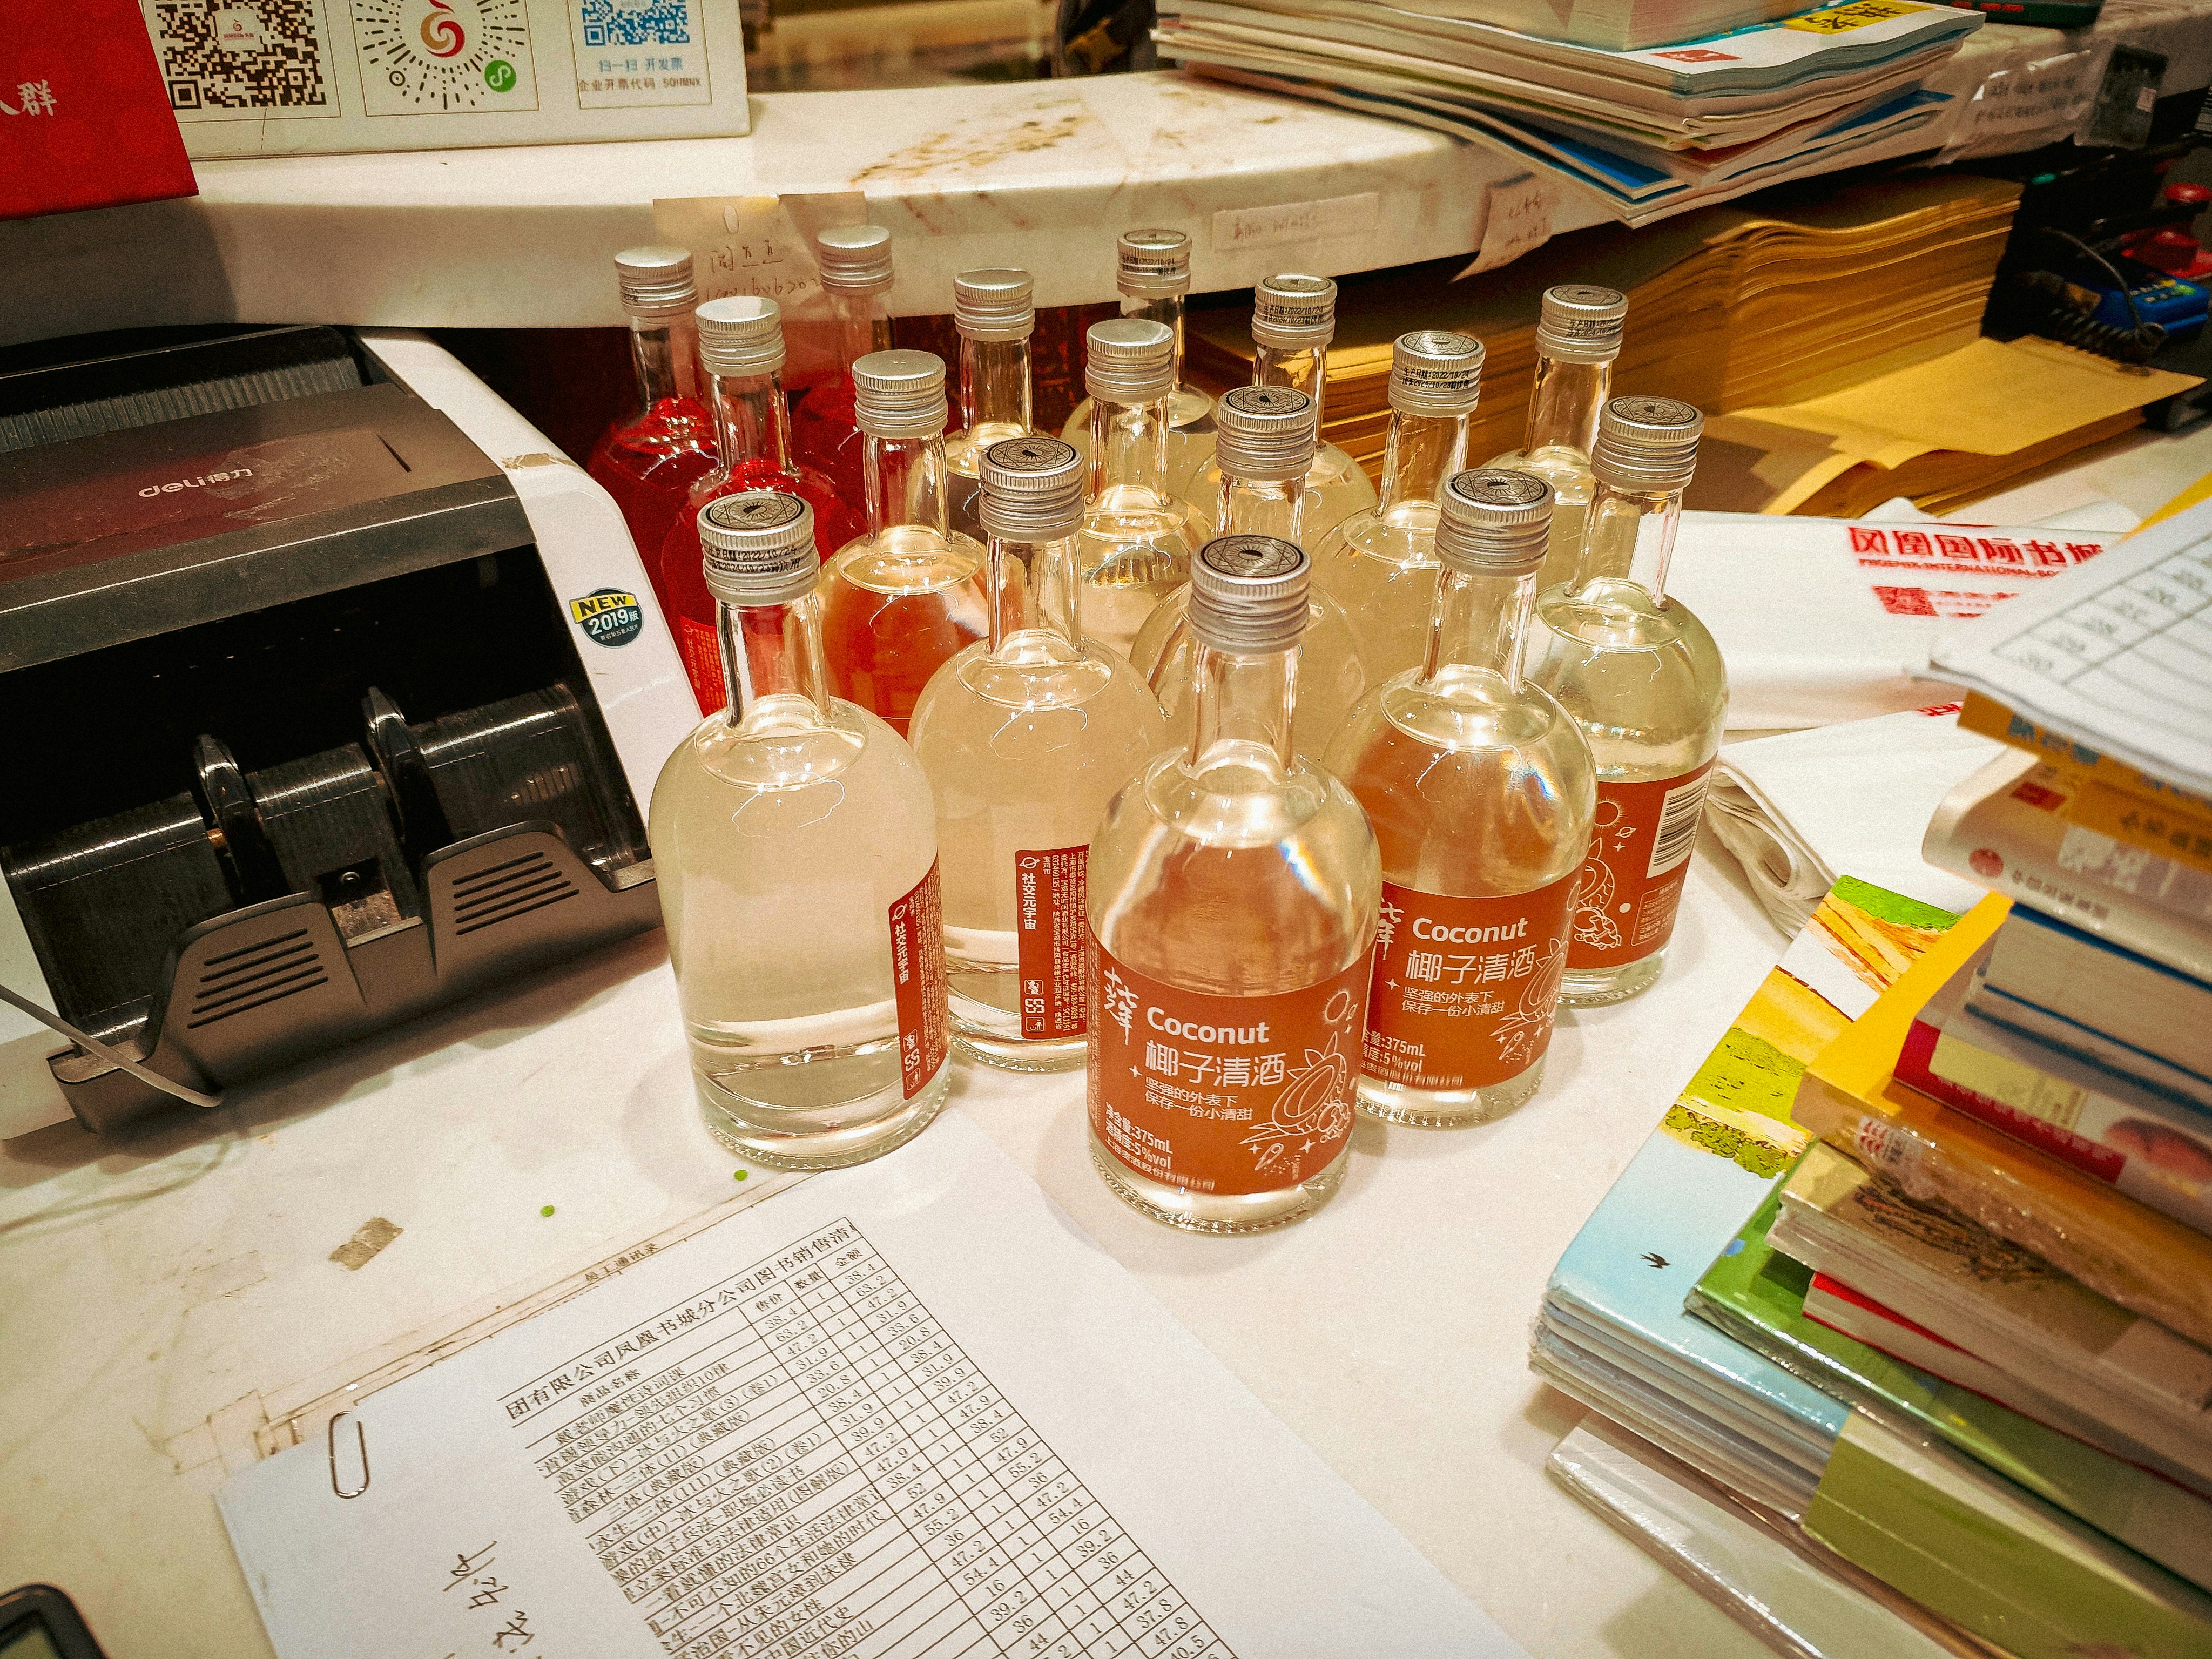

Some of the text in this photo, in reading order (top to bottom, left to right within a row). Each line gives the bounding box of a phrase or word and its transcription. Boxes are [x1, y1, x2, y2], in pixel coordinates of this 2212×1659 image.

[578, 595, 626, 617] NEW
[1021, 872, 1037, 930] 社交元宇宙
[1412, 917, 1528, 944] Coconut
[894, 921, 910, 984] 社交元宇宙
[1405, 943, 1537, 985] 椰子清酒
[1147, 1007, 1270, 1044] Coconut
[1401, 999, 1505, 1017] 保存一份小清甜
[1402, 986, 1494, 1004] 坚强的外表下
[1144, 1039, 1286, 1088] 椰子清酒
[1144, 1077, 1238, 1108] 坚强的外表下
[1144, 1090, 1252, 1121] 保存一份小清甜
[584, 1243, 659, 1282] 员工通讯录
[765, 1307, 798, 1328] 38.4
[845, 1264, 876, 1284] 38.4
[579, 1250, 863, 1408] 商品名称 售价 数量 金额
[788, 1334, 818, 1354] 47.2
[868, 1289, 898, 1308] 47.2
[796, 1348, 827, 1370] 31.9
[876, 1301, 907, 1323] 31.9
[806, 1361, 839, 1383] 33.6
[887, 1314, 919, 1336] 33.6
[537, 1363, 730, 1475] 肯锡领导力-领先组织10律
[776, 1320, 808, 1342] 63.2
[856, 1276, 887, 1296] 63.2
[818, 1375, 851, 1398] 20.8
[899, 1327, 930, 1350] 20.8
[828, 1389, 862, 1412] 38.4
[910, 1341, 942, 1363] 38.4
[840, 1404, 872, 1427] 31.9
[893, 1386, 902, 1394] 1
[922, 1354, 953, 1377] 31.9
[851, 1418, 884, 1441] 39.9
[905, 1400, 914, 1409] 1
[933, 1368, 965, 1391] 39.9
[866, 1433, 898, 1455] 47.2
[948, 1381, 979, 1403] 47.2
[878, 1448, 908, 1471] 47.9
[928, 1429, 938, 1438] 1
[960, 1395, 990, 1417] 47.9
[887, 1463, 922, 1488] 38.4
[940, 1444, 950, 1453] 1
[970, 1410, 1003, 1433] 38.4
[906, 1483, 927, 1499] 52
[953, 1459, 963, 1468] 1
[990, 1428, 1009, 1443] 52
[914, 1493, 945, 1518] 47.9
[965, 1474, 975, 1483] 1
[997, 1438, 1028, 1461] 47.9
[924, 1509, 959, 1535] 55.2
[977, 1489, 989, 1499] 1
[1008, 1452, 1042, 1478] 55.2
[944, 1529, 965, 1546] 36
[991, 1505, 1002, 1514] 1
[1028, 1472, 1048, 1488] 36
[952, 1541, 986, 1567] 47.2
[1004, 1521, 1015, 1530] 1
[1037, 1482, 1069, 1507] 47.2
[963, 1498, 1083, 1585] 54.4 1 54.4
[986, 1519, 1089, 1597] 16 1 16
[990, 1530, 1112, 1621] 39.2 1 39.2
[1013, 1552, 1118, 1633] 36 1 36
[1030, 1569, 1135, 1650] 44 1 44
[1090, 1581, 1157, 1634] 1 47.2
[1105, 1599, 1172, 1653] 1 37.8
[1155, 1617, 1188, 1646] 47.8
